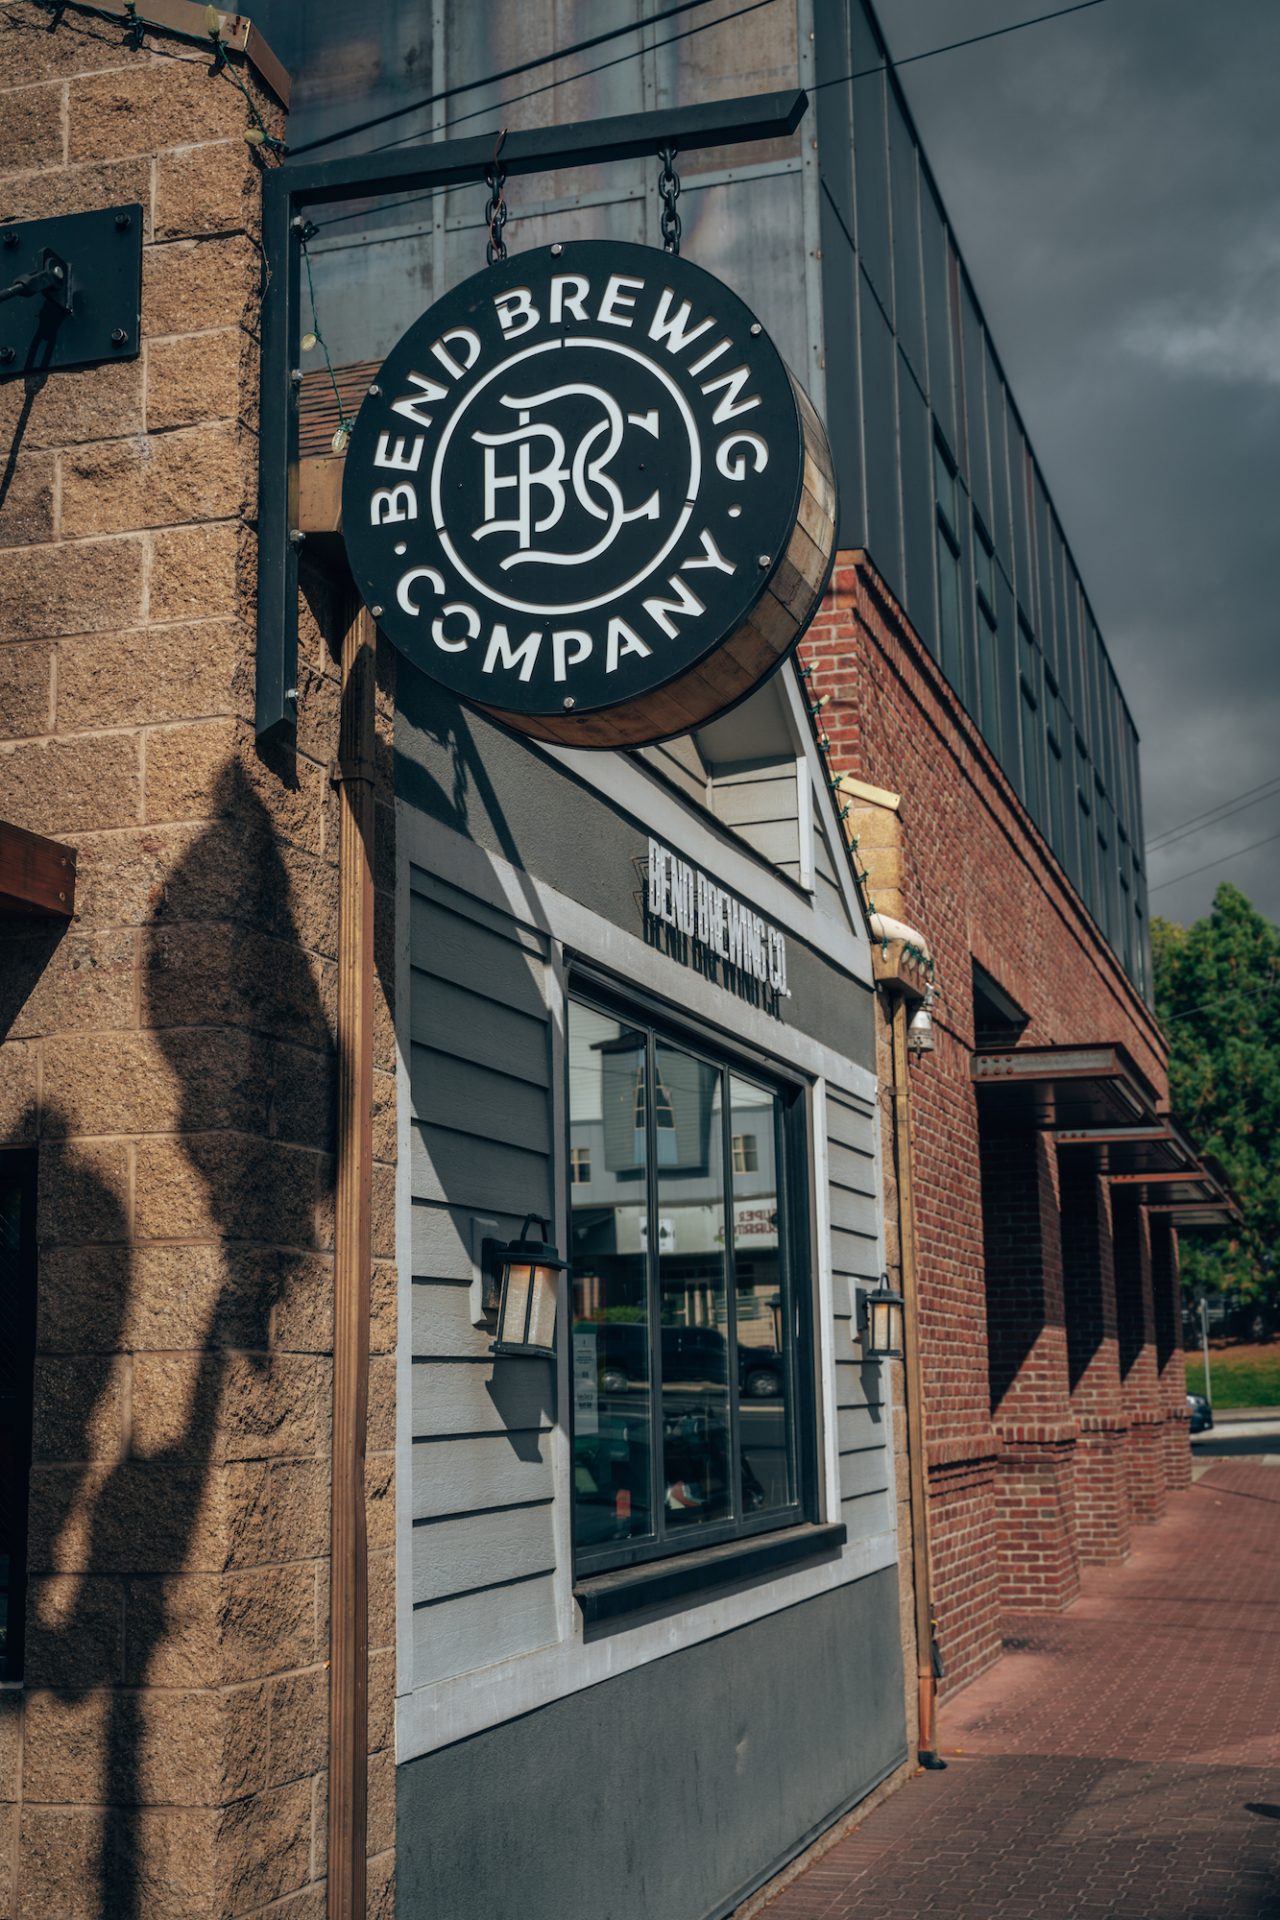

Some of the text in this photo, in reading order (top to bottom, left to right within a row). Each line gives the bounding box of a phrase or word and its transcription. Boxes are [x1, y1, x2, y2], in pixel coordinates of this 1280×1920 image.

[371, 272, 769, 526] BEND BREWING
[396, 527, 738, 683] COMPANY
[648, 836, 695, 937] BEND
[697, 870, 767, 983] BREWING
